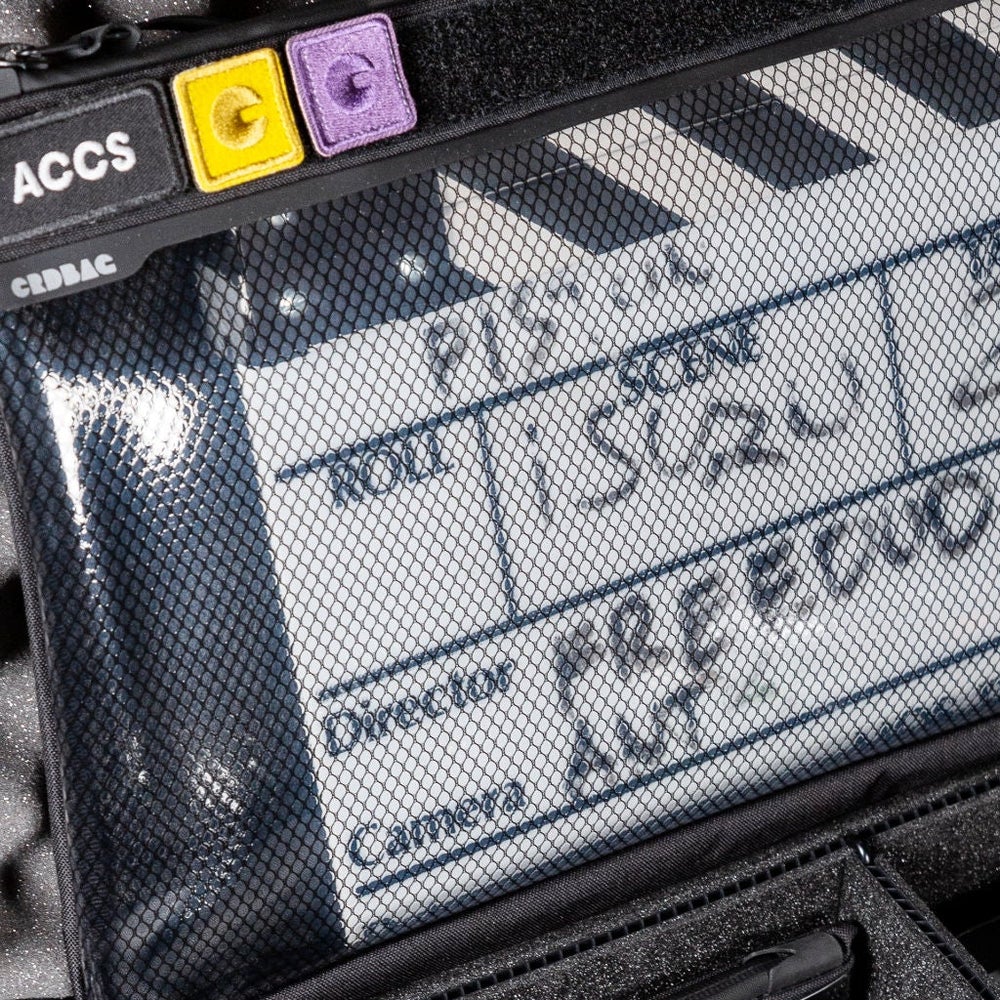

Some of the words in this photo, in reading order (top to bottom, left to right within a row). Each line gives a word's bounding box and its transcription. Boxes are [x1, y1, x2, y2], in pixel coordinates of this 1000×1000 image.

[12, 131, 136, 204] ACCS
[11, 254, 117, 298] CRDBAG
[617, 318, 763, 399] SCENE
[326, 429, 454, 508] ROLL
[322, 659, 514, 759] Director
[347, 777, 529, 871] Camera
